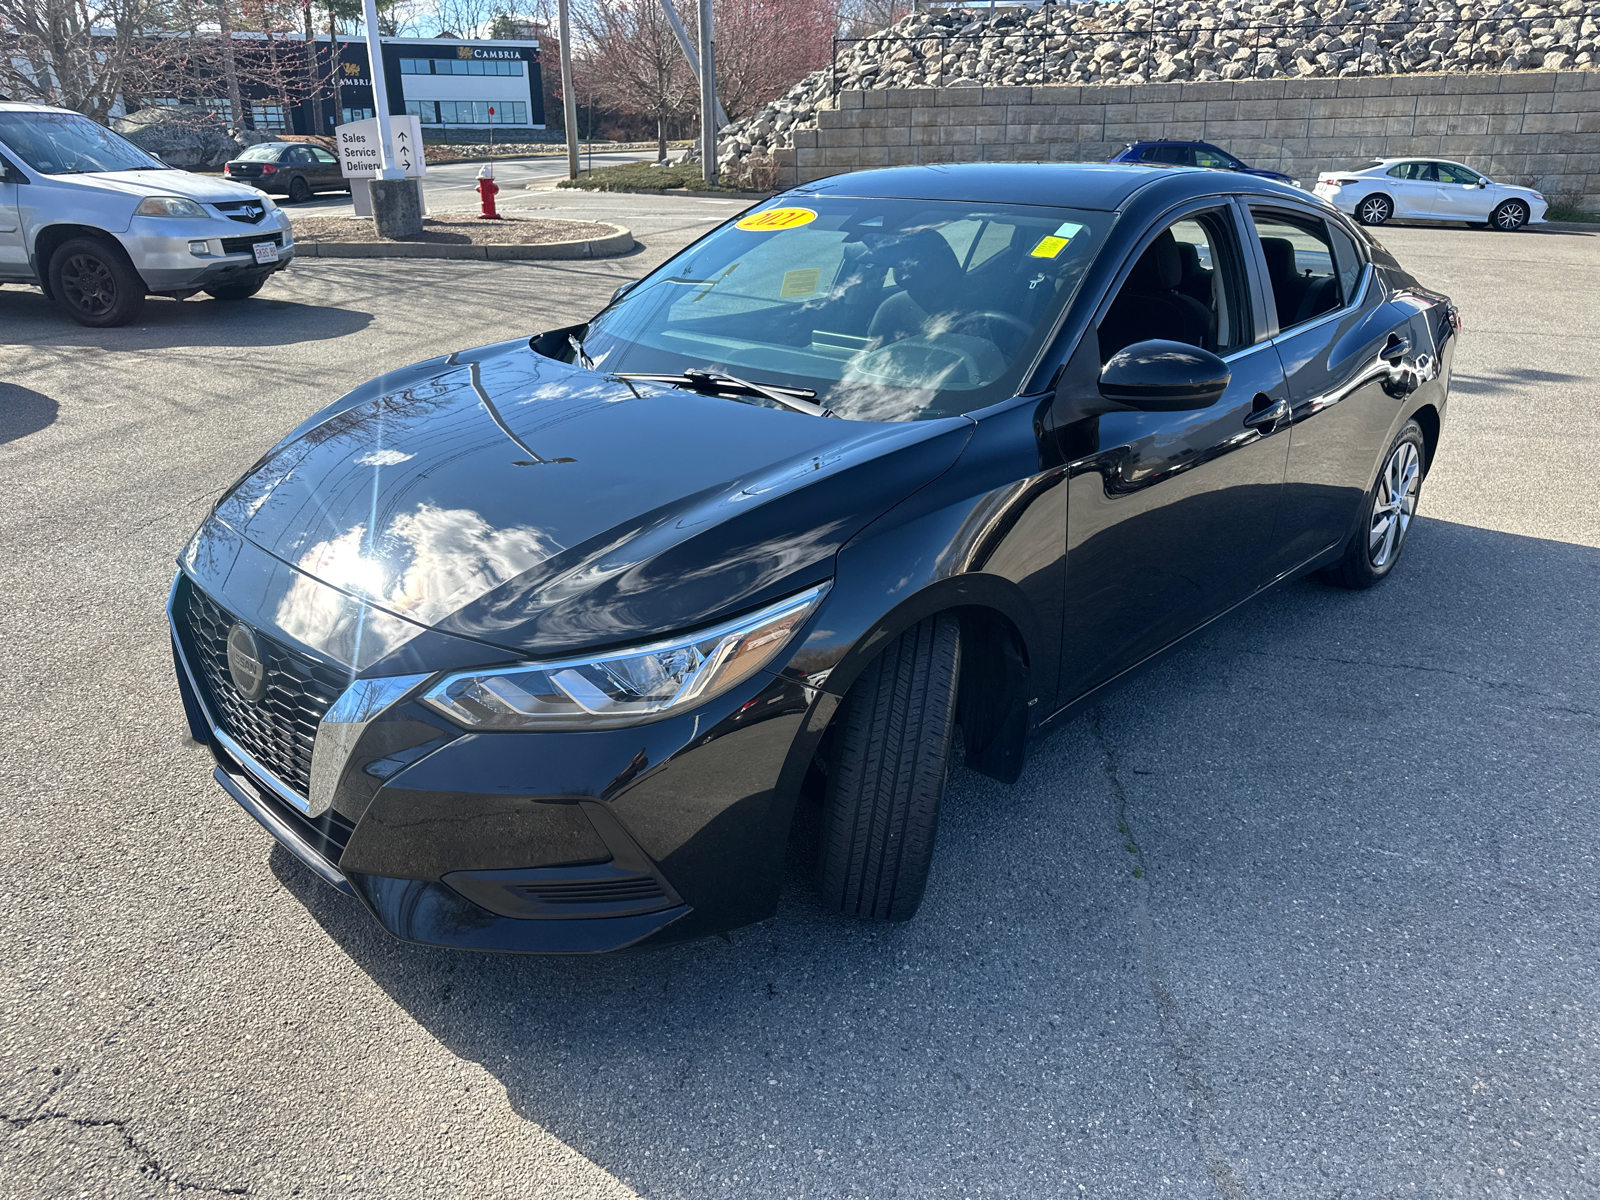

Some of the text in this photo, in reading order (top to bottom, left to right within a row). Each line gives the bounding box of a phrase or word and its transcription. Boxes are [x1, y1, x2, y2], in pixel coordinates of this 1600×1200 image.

[474, 49, 521, 59] CAMBRIA
[342, 133, 366, 143] Sales
[344, 147, 376, 157] Service
[742, 211, 808, 226] 2021
